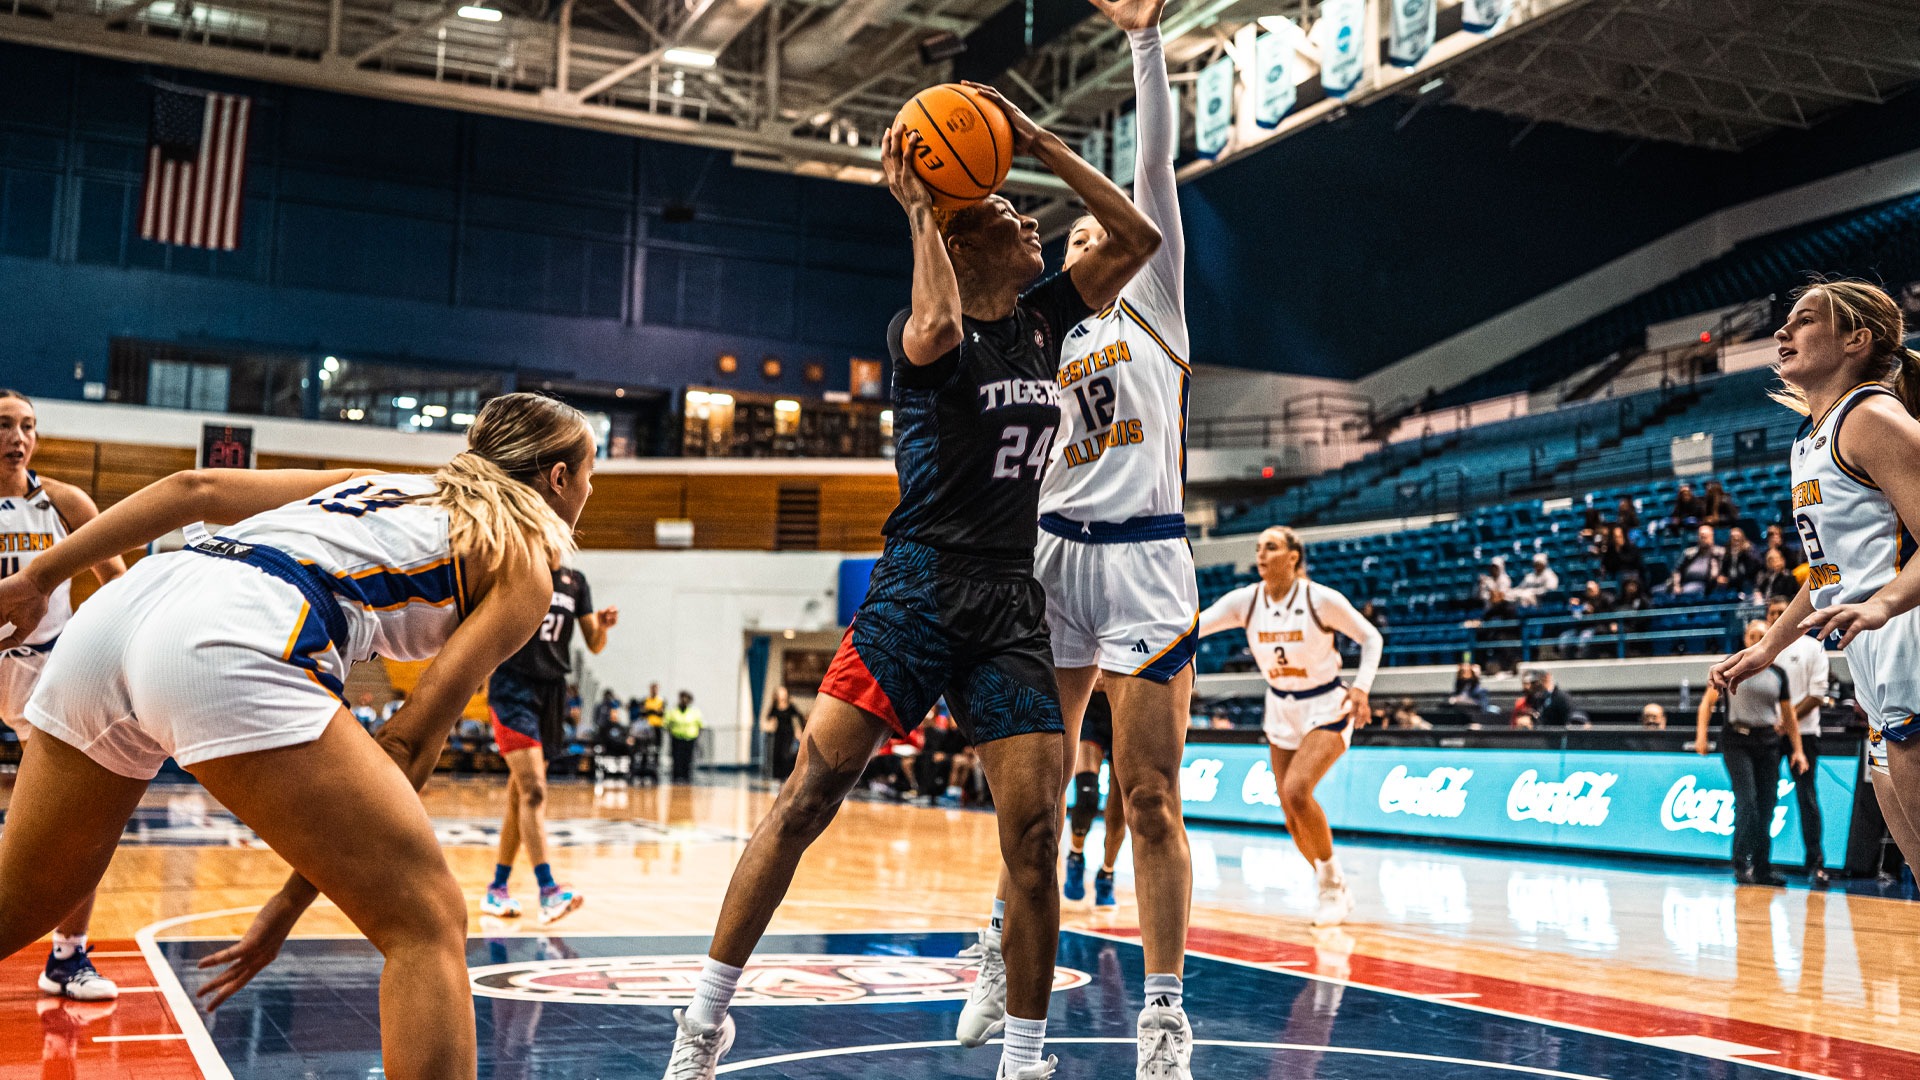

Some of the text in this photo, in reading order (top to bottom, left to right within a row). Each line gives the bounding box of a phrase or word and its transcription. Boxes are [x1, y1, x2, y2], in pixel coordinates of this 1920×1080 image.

[1056, 339, 1132, 391] ESTERN
[1073, 375, 1116, 433] 12
[993, 425, 1055, 480] 24
[540, 612, 565, 641] 21
[1274, 646, 1288, 666] 3
